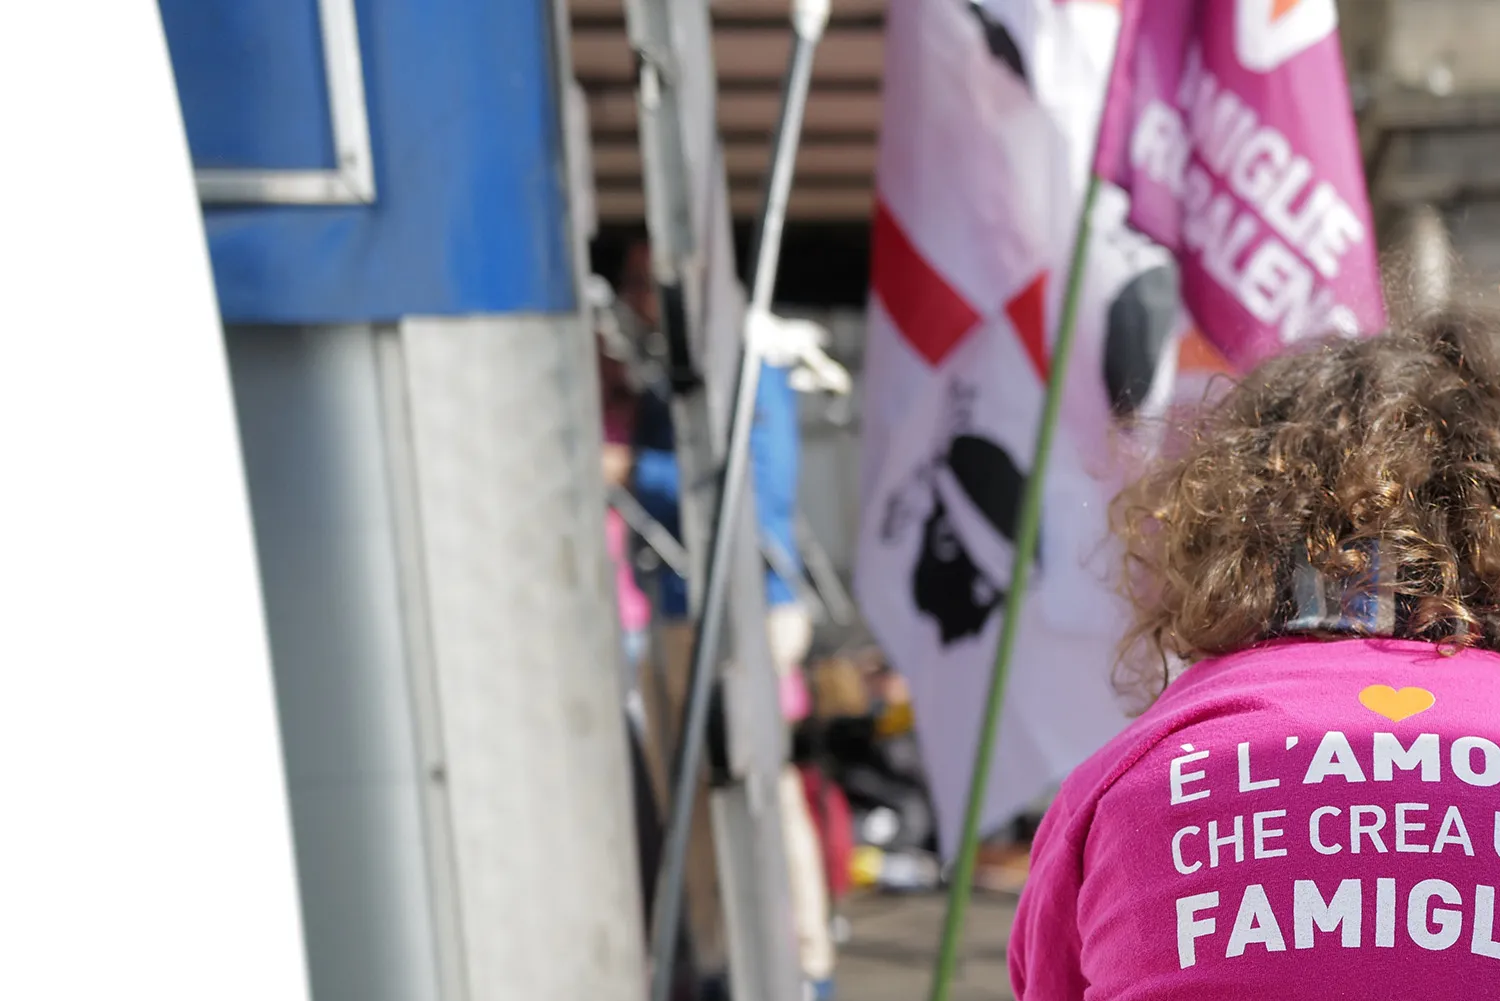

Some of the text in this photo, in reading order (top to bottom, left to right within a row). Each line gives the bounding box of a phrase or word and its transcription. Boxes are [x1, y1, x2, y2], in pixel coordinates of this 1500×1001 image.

[1170, 742, 1211, 806] È
[1171, 808, 1288, 876] CHE
[1308, 802, 1475, 857] CREA
